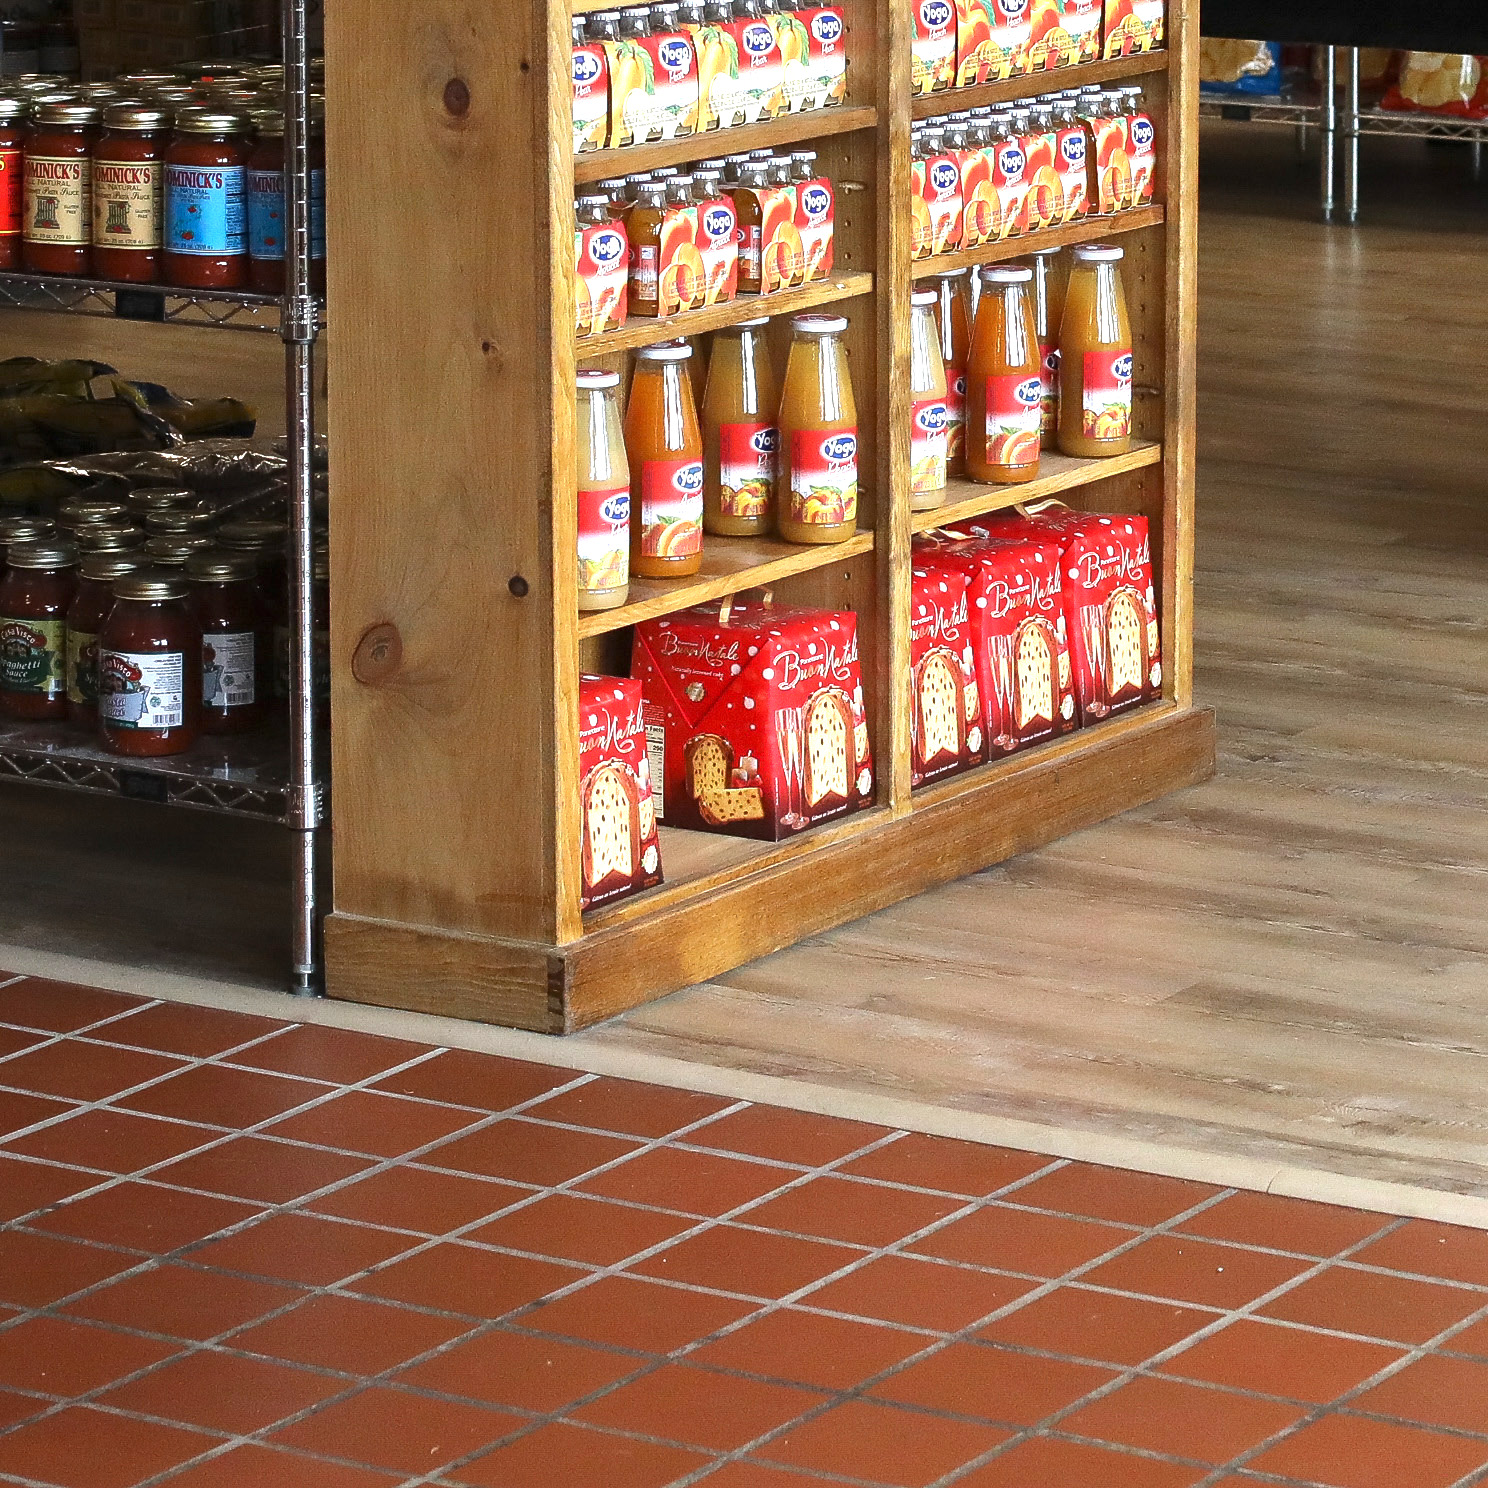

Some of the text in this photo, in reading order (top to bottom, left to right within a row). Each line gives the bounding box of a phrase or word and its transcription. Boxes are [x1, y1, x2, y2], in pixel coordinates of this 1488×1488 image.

[923, 3, 950, 25] Yoga
[812, 17, 841, 37] Yoga
[744, 29, 773, 51] Yoga
[661, 44, 691, 65] Yoga
[1132, 122, 1154, 141] Yoga
[1063, 138, 1086, 157] Yoga
[25, 162, 81, 180] OMINICK'S
[1001, 151, 1025, 173] Yoga
[37, 178, 71, 188] NATURAL
[95, 167, 151, 185] OMINICK'S
[166, 170, 224, 189] OMINICK'S
[932, 165, 958, 185] Yoga
[804, 191, 831, 211] Yoga
[705, 212, 732, 233] Yoga
[592, 236, 623, 260] Yoga
[828, 438, 856, 458] Yoga
[827, 459, 855, 473] Peach
[1077, 551, 1122, 589] Buon
[1100, 555, 1121, 565] Panettone
[1008, 584, 1031, 594] Panettone
[985, 580, 1031, 619] Buon
[15, 626, 36, 644] Visco
[799, 653, 825, 664] Panettone
[5, 669, 29, 678] Sauce
[773, 650, 826, 690] Buon
